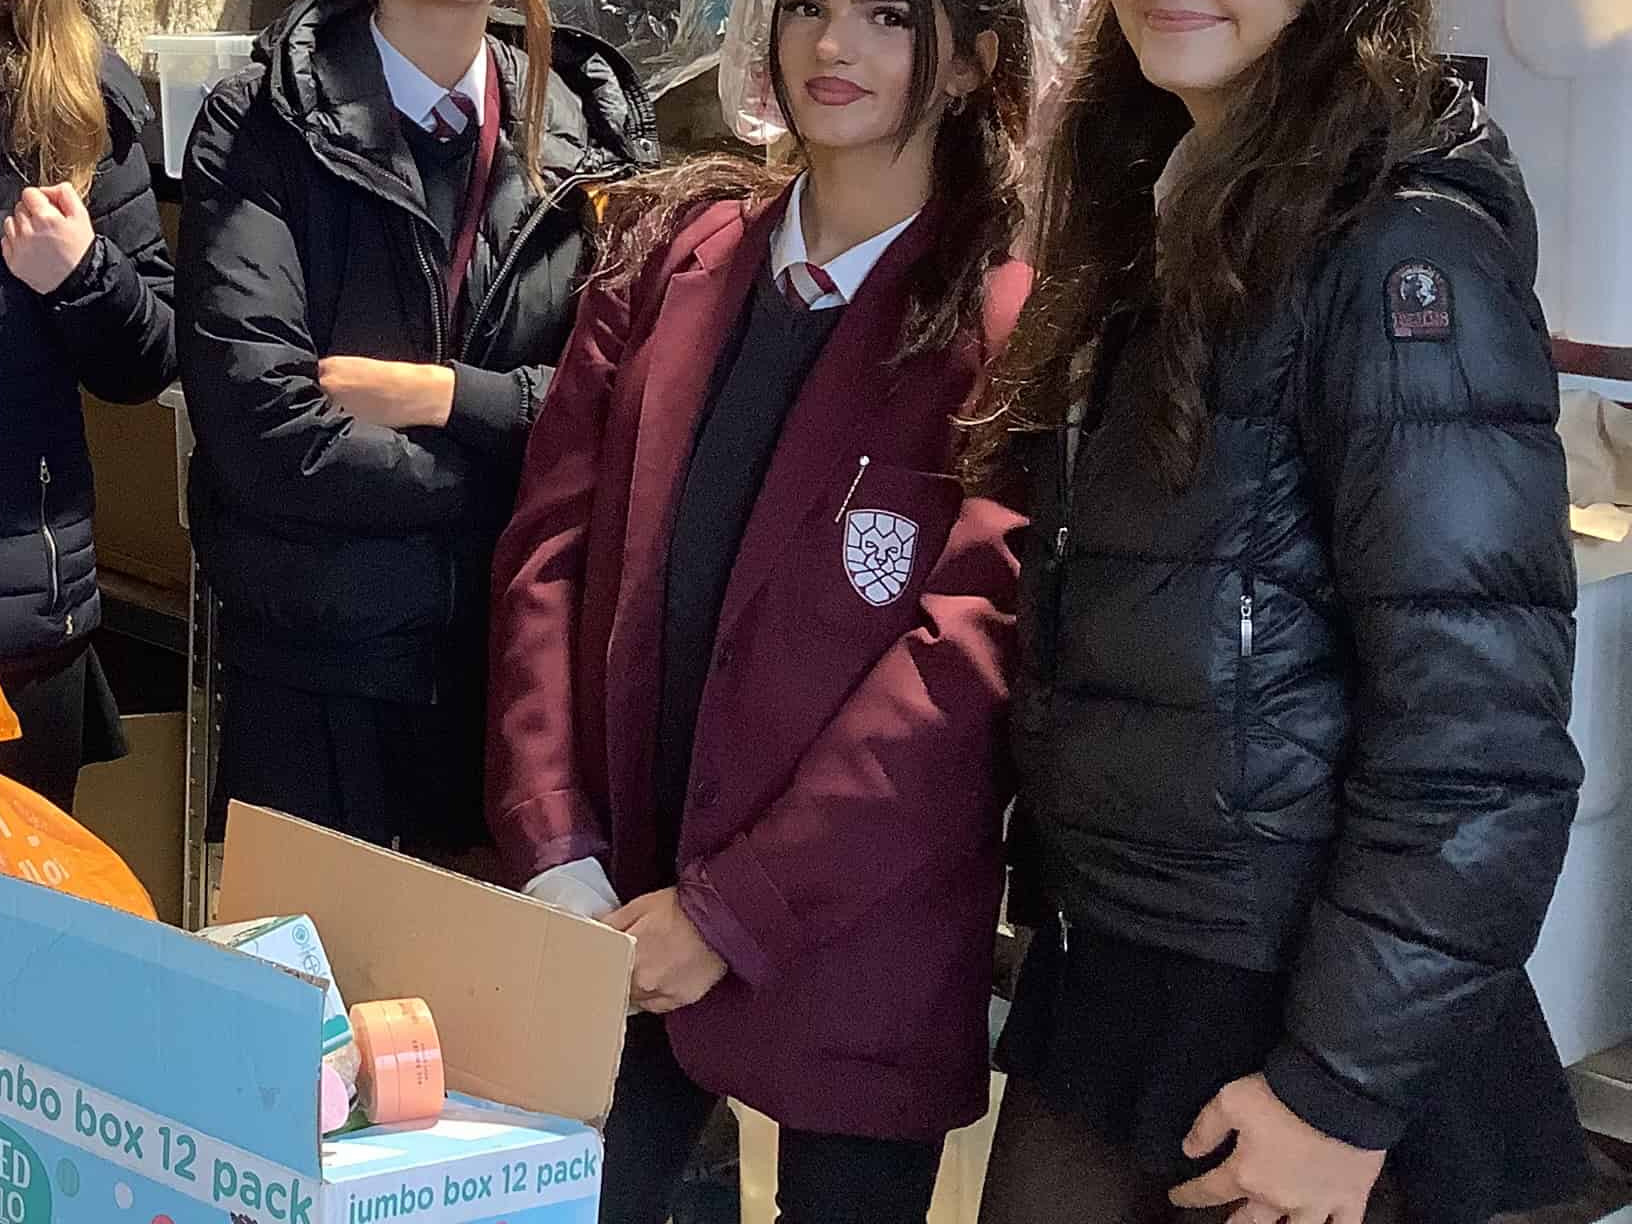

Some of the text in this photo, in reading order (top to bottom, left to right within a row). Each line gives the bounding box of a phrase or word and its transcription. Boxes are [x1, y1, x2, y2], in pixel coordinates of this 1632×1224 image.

[75, 1087, 144, 1159] box
[158, 1125, 197, 1182] 12
[211, 1157, 313, 1224] pack
[348, 1147, 598, 1224] jumbo box 12 pack
